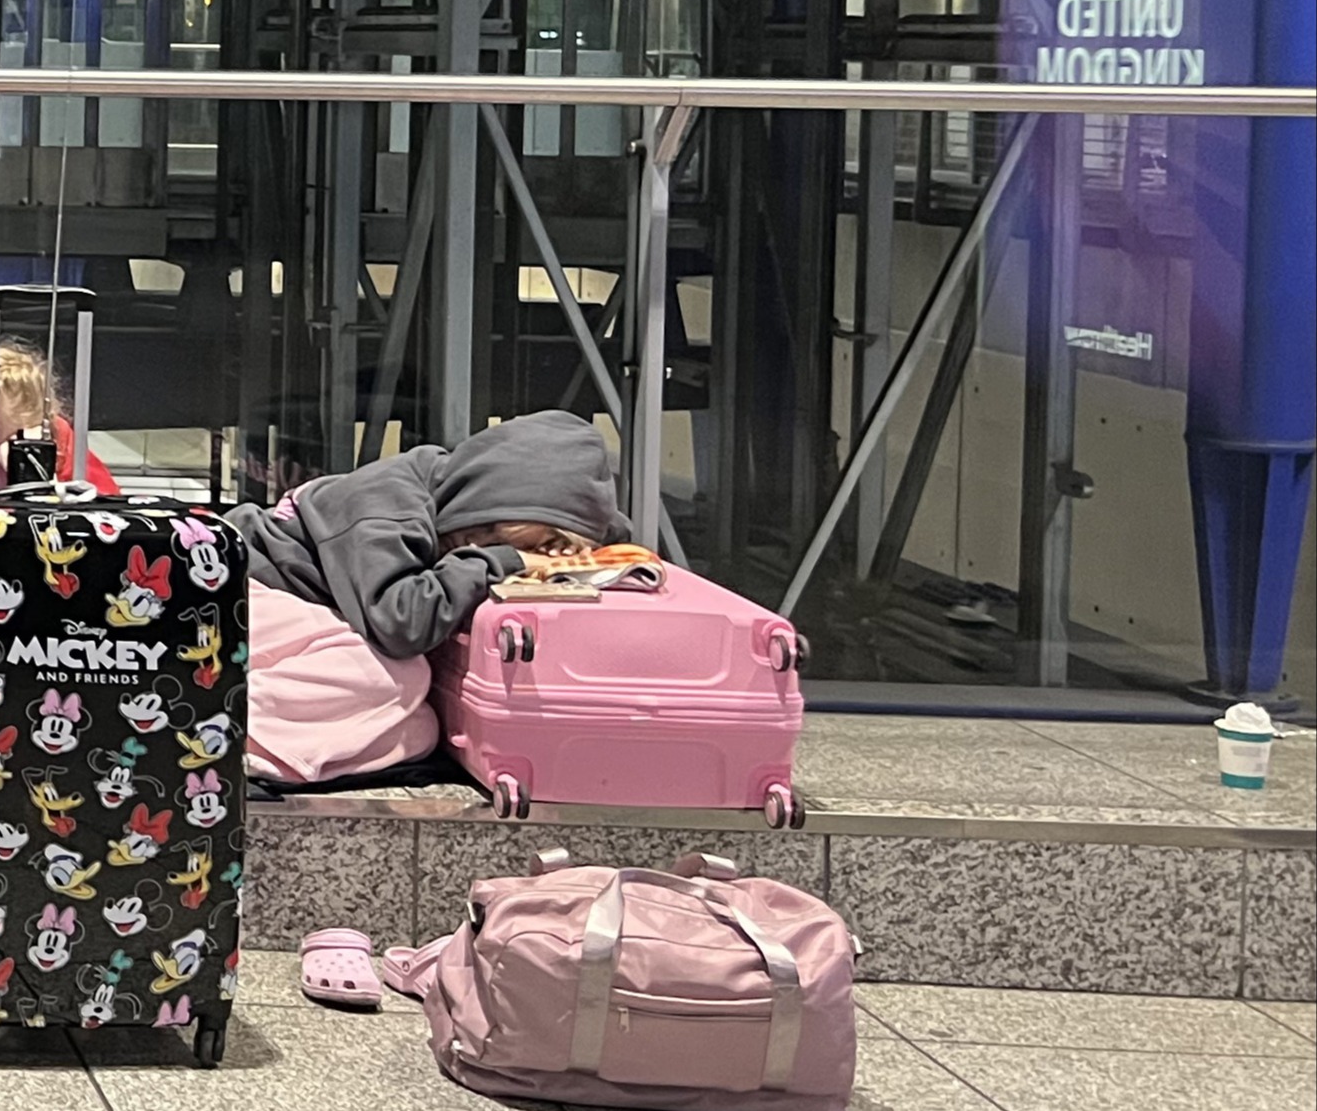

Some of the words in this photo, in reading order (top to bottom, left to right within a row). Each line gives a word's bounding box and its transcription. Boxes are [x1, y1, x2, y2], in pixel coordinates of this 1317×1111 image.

[60, 618, 107, 640] Disney
[6, 635, 168, 671] MICKEY
[36, 671, 69, 683] AND
[75, 672, 139, 685] FRIENDS
